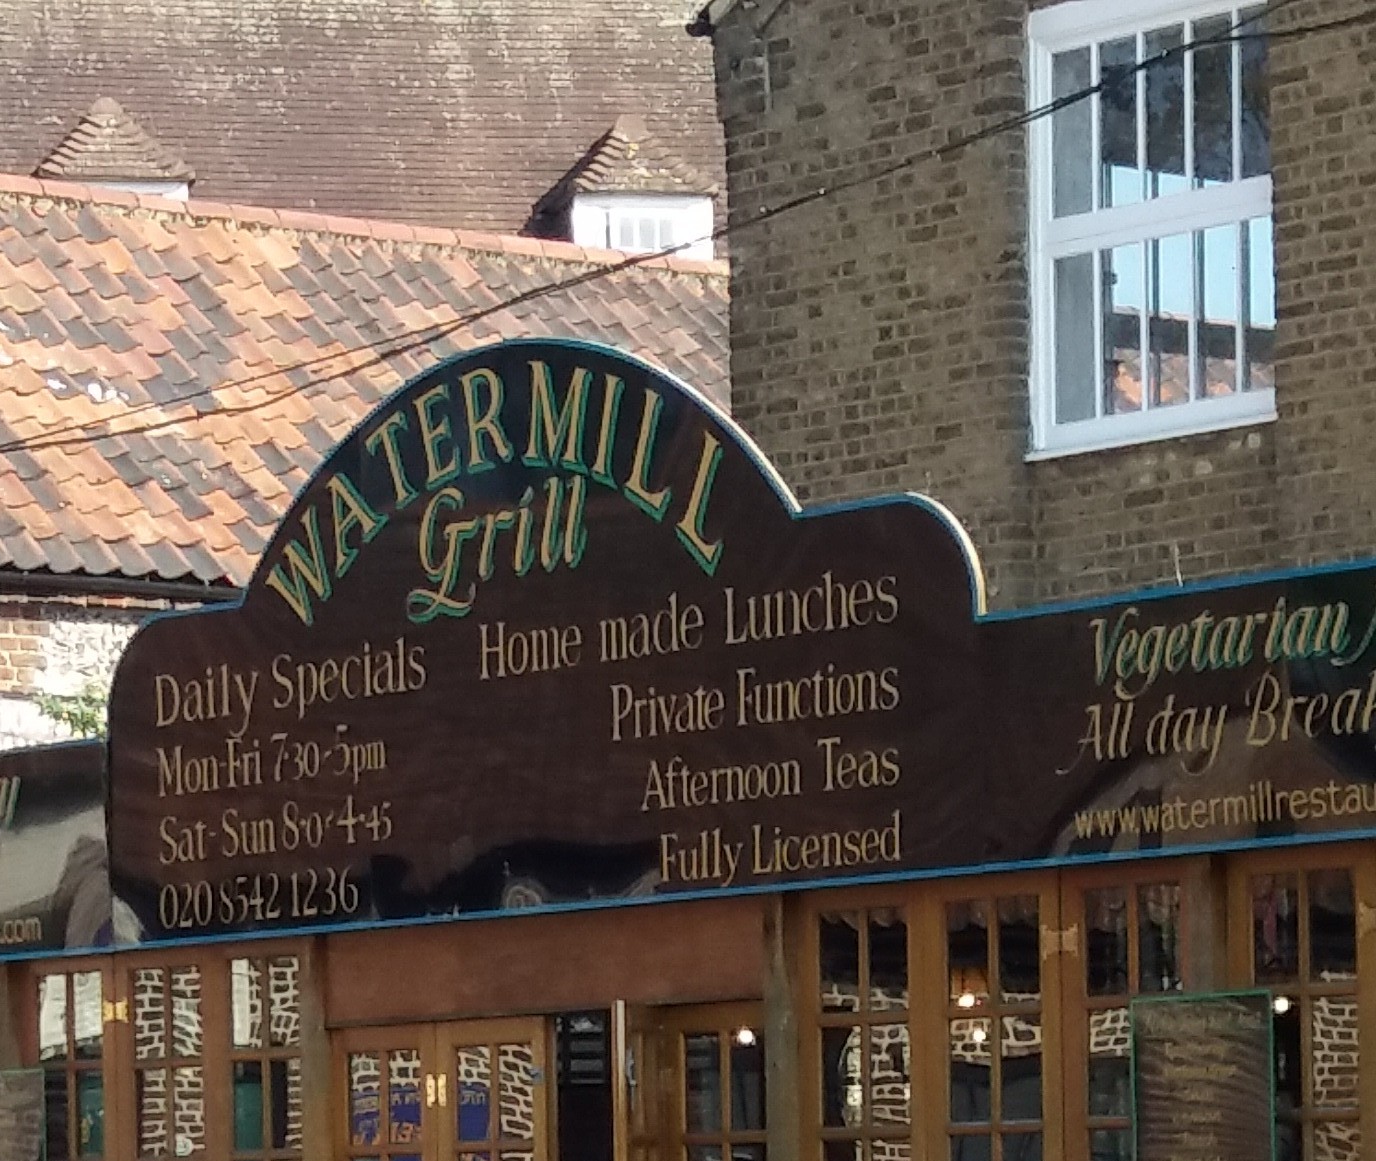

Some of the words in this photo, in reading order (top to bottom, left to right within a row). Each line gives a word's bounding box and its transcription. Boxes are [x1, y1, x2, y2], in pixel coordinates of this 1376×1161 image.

[265, 361, 724, 627] WATERMILL
[407, 475, 587, 623] Grill
[478, 620, 582, 681] Home
[599, 591, 705, 663] made
[724, 570, 899, 647] Lunches
[1089, 596, 1351, 701] Vegetarian
[155, 663, 259, 738] Daily
[271, 638, 426, 720] Specials
[610, 683, 725, 742] Private
[736, 663, 900, 727] Functions
[155, 736, 263, 798] Mon-Fri
[640, 755, 803, 812] Afternoon
[816, 736, 901, 792] Teas
[1055, 701, 1135, 775] All
[1145, 694, 1228, 777] day
[660, 826, 743, 887] Fully
[751, 808, 902, 876] Licensed
[159, 879, 213, 930] 020
[218, 872, 282, 925] 8542
[290, 864, 359, 916] 1236
